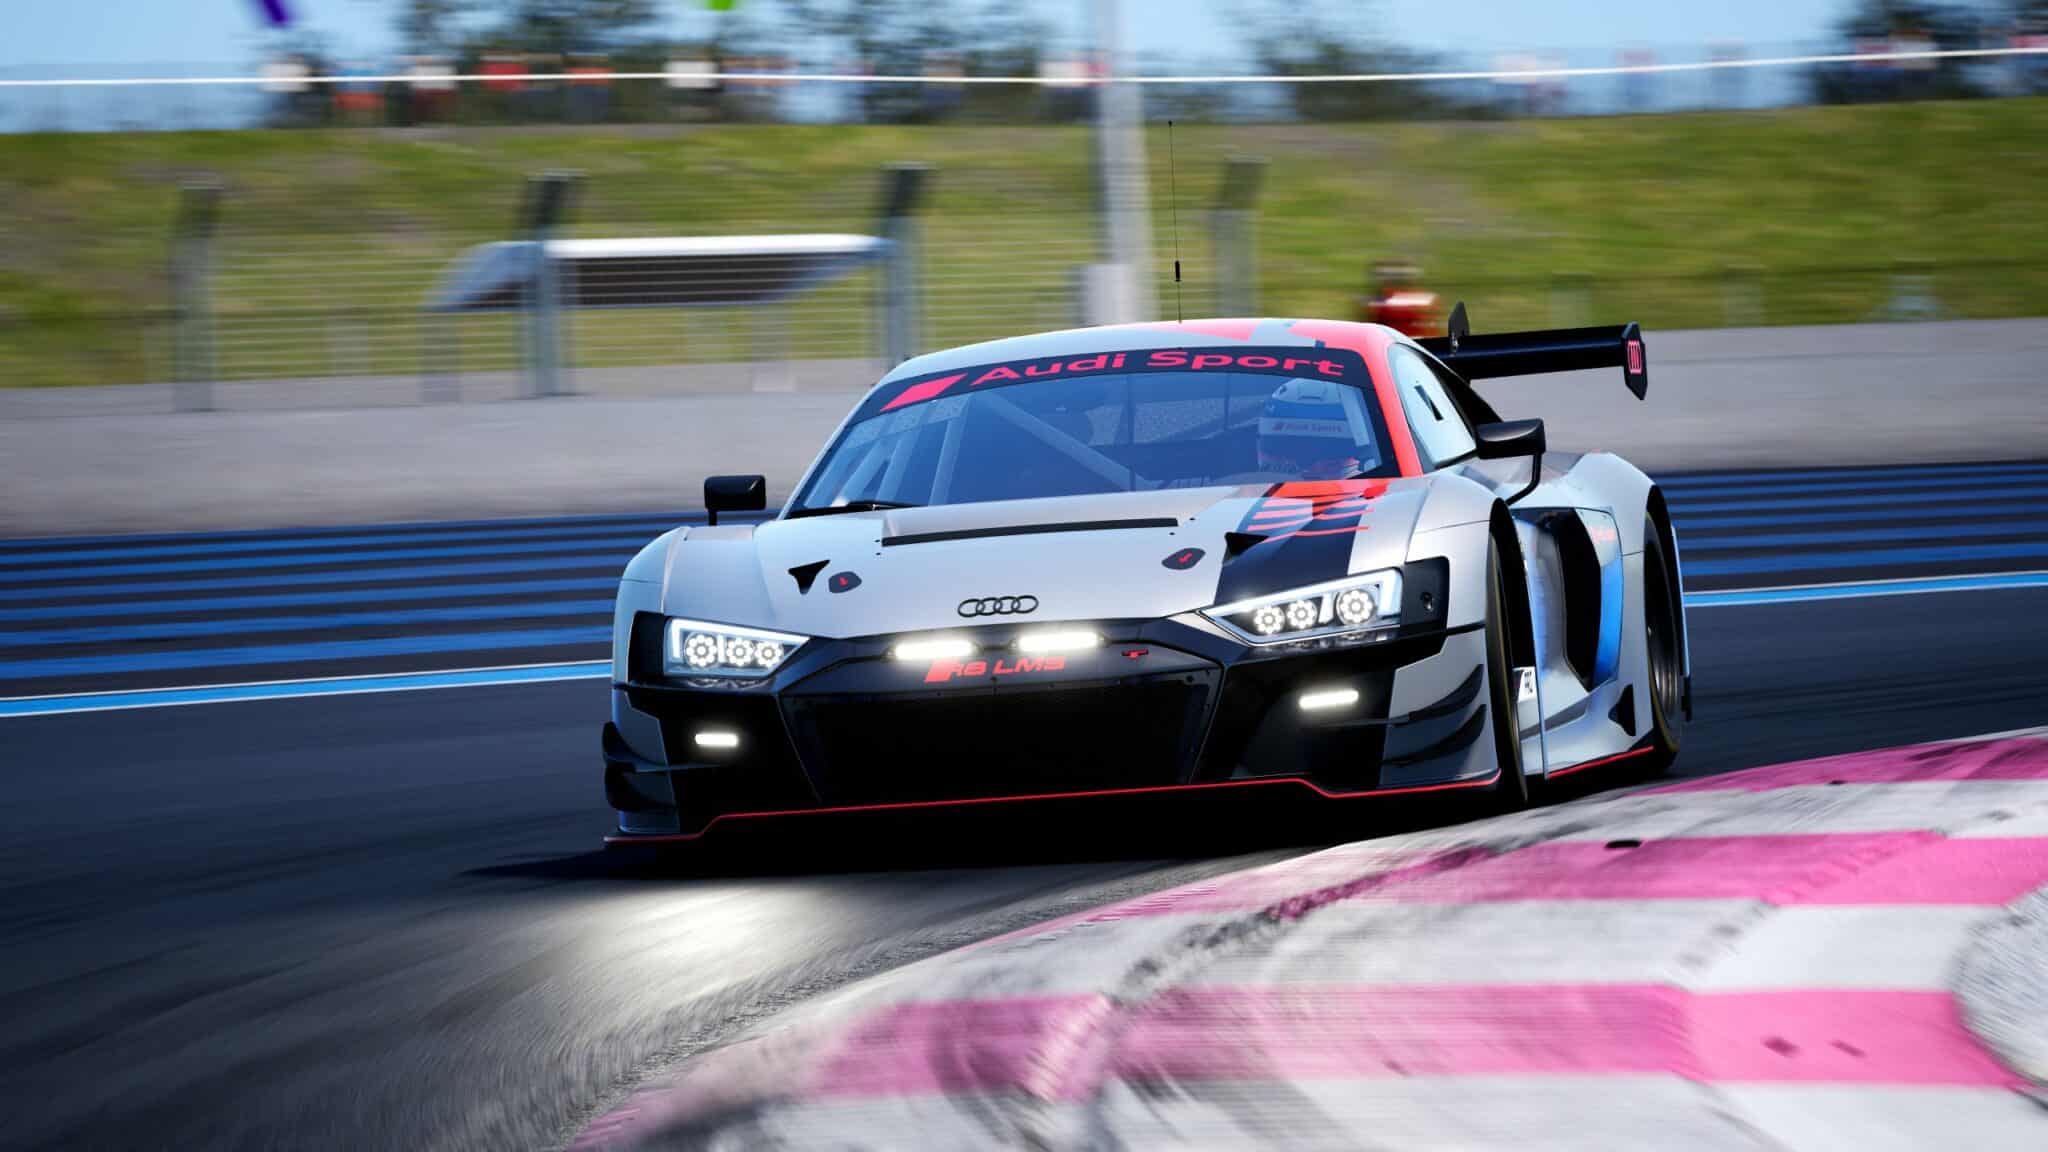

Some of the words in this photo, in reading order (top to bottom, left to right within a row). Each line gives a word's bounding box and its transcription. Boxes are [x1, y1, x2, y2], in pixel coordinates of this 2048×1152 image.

[970, 352, 1126, 386] Audi
[1147, 351, 1344, 377] Sport
[946, 660, 987, 677] R8
[992, 656, 1066, 675] LMS
